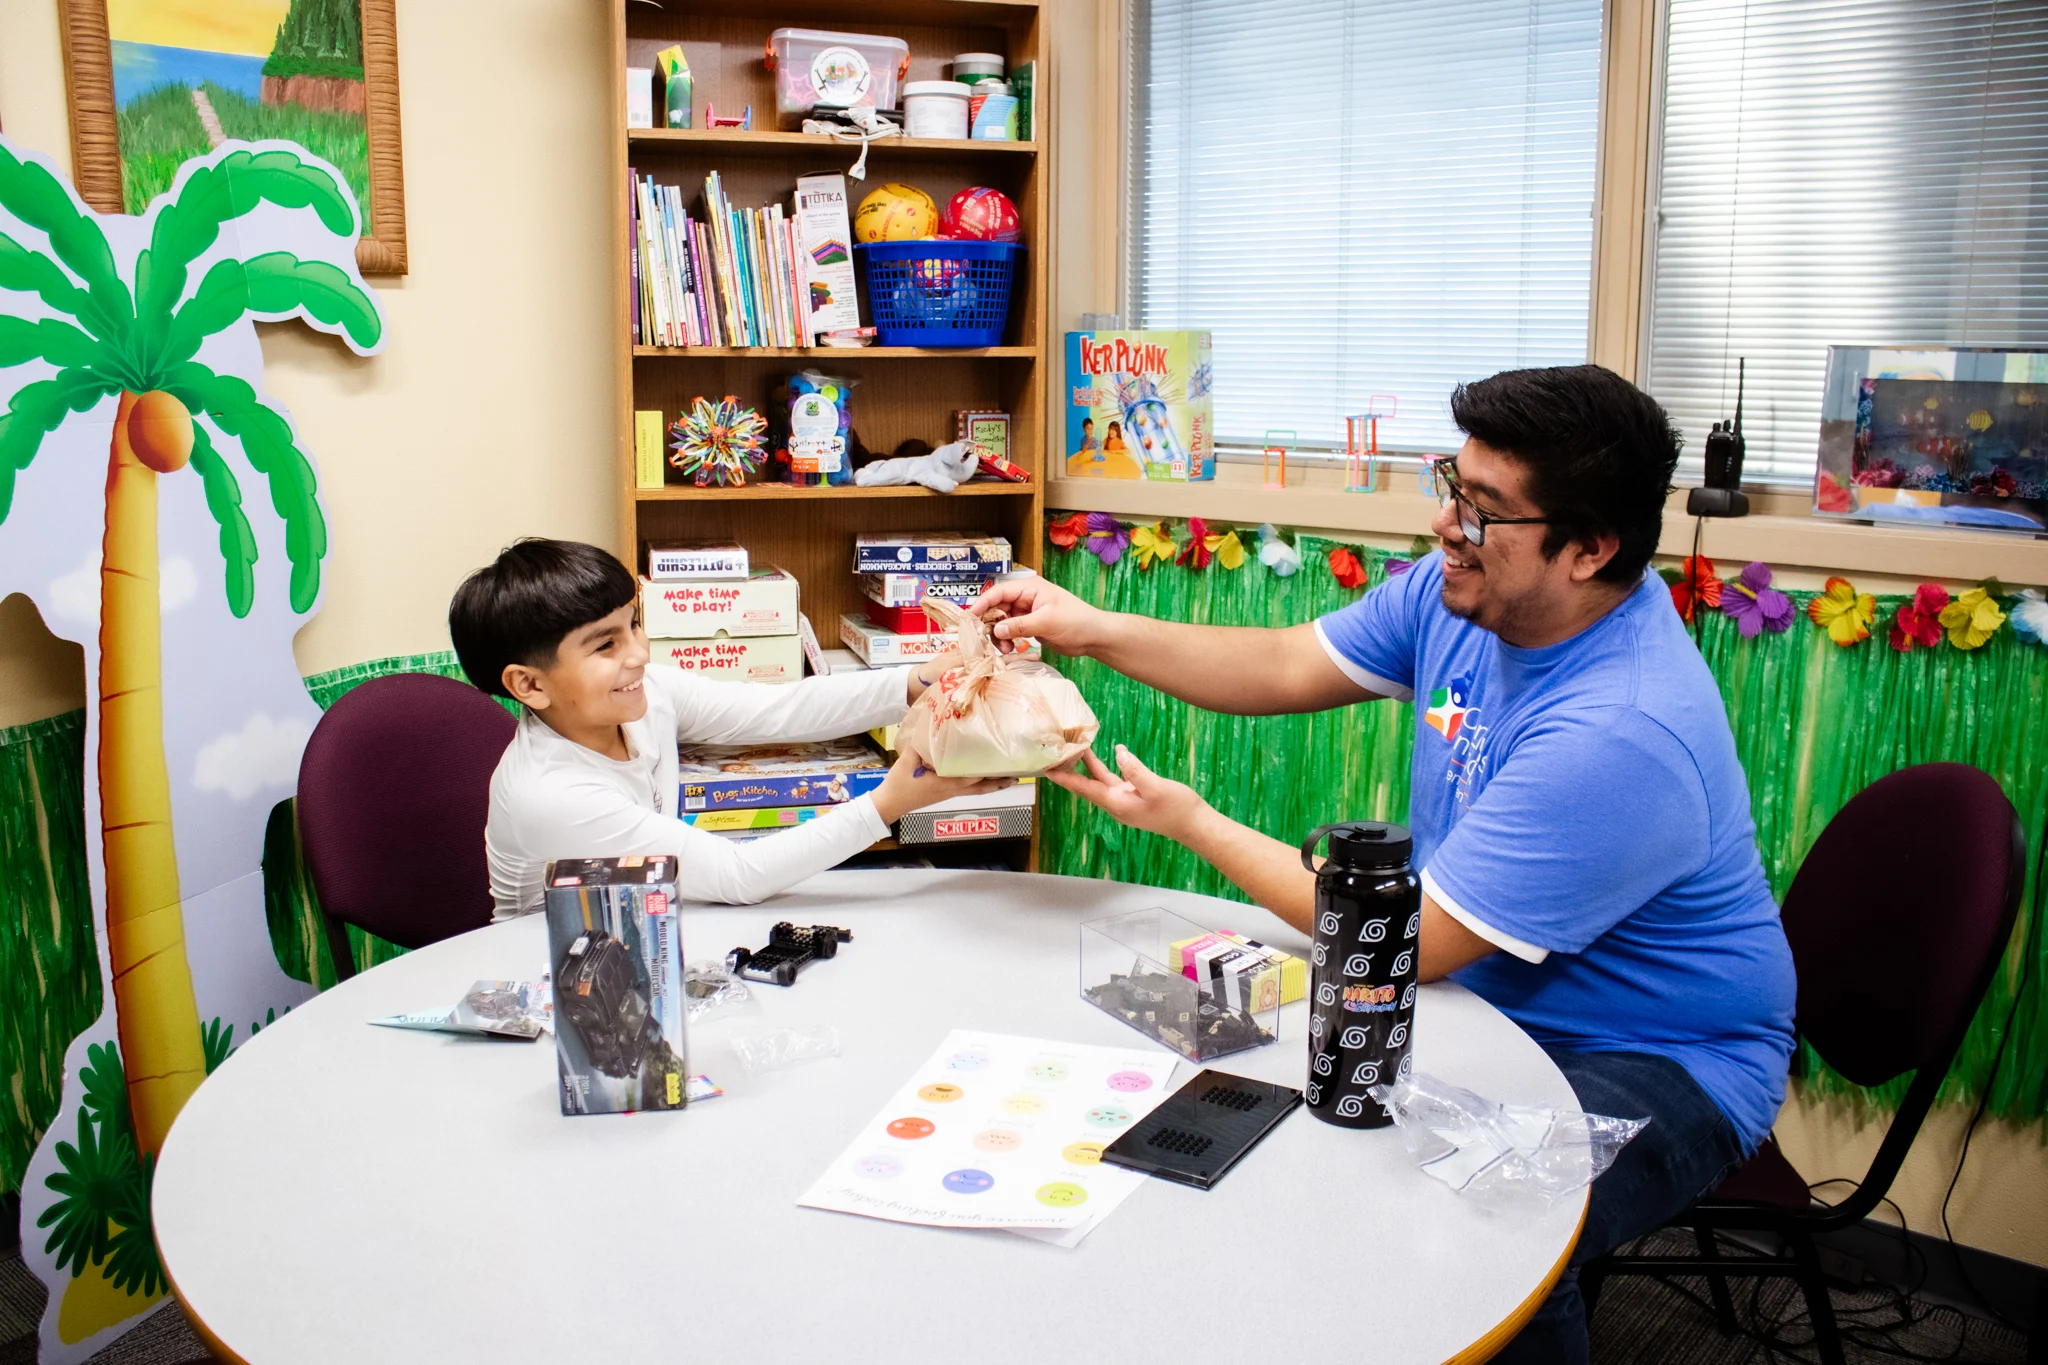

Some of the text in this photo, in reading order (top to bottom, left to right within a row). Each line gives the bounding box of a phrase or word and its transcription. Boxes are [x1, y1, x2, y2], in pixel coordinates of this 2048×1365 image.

[860, 562, 978, 571] CHESS CHECKERS BACKGAMMON
[926, 584, 982, 597] CONNECT
[672, 601, 732, 613] to play!
[901, 641, 959, 655] MONOPO
[679, 656, 739, 670] to play!
[712, 789, 740, 804] Bugs
[742, 785, 780, 798] Kitchen
[937, 819, 996, 836] SCRUPLES
[659, 921, 667, 945] MOULD
[660, 946, 669, 965] KING
[651, 958, 660, 997] MODEL CAR
[1342, 985, 1396, 1004] NARUTO
[582, 1075, 590, 1095] 27014
[886, 1200, 948, 1222] feeling
